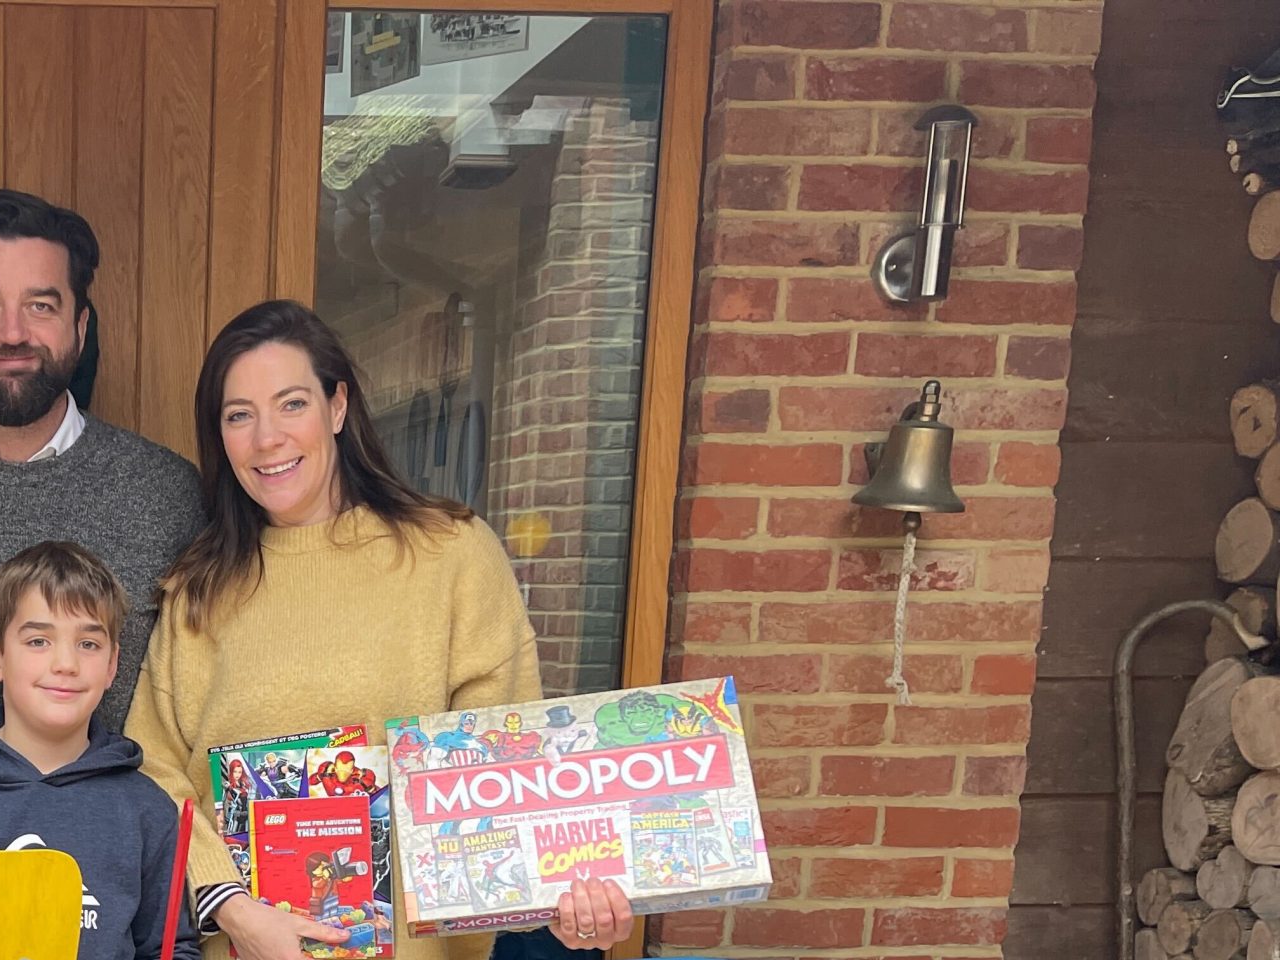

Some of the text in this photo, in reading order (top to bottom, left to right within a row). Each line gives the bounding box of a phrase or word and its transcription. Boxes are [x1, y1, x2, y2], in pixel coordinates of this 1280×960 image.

[328, 729, 364, 748] CADEAU!
[425, 743, 717, 814] MONOPOLY
[265, 814, 286, 824] LEGO
[325, 818, 361, 826] ADVENTURE
[493, 817, 508, 825] The
[509, 811, 559, 824] Fast-Dealing
[560, 808, 596, 819] Property
[631, 819, 690, 830] AMERICA
[296, 826, 362, 837] THE MISSION
[463, 830, 513, 847] AMAZING
[533, 817, 619, 848] MARVEL
[437, 841, 459, 853] HU
[470, 840, 506, 852] FANTASY
[537, 838, 624, 876] COMICS
[456, 910, 560, 929] MONOPOL
